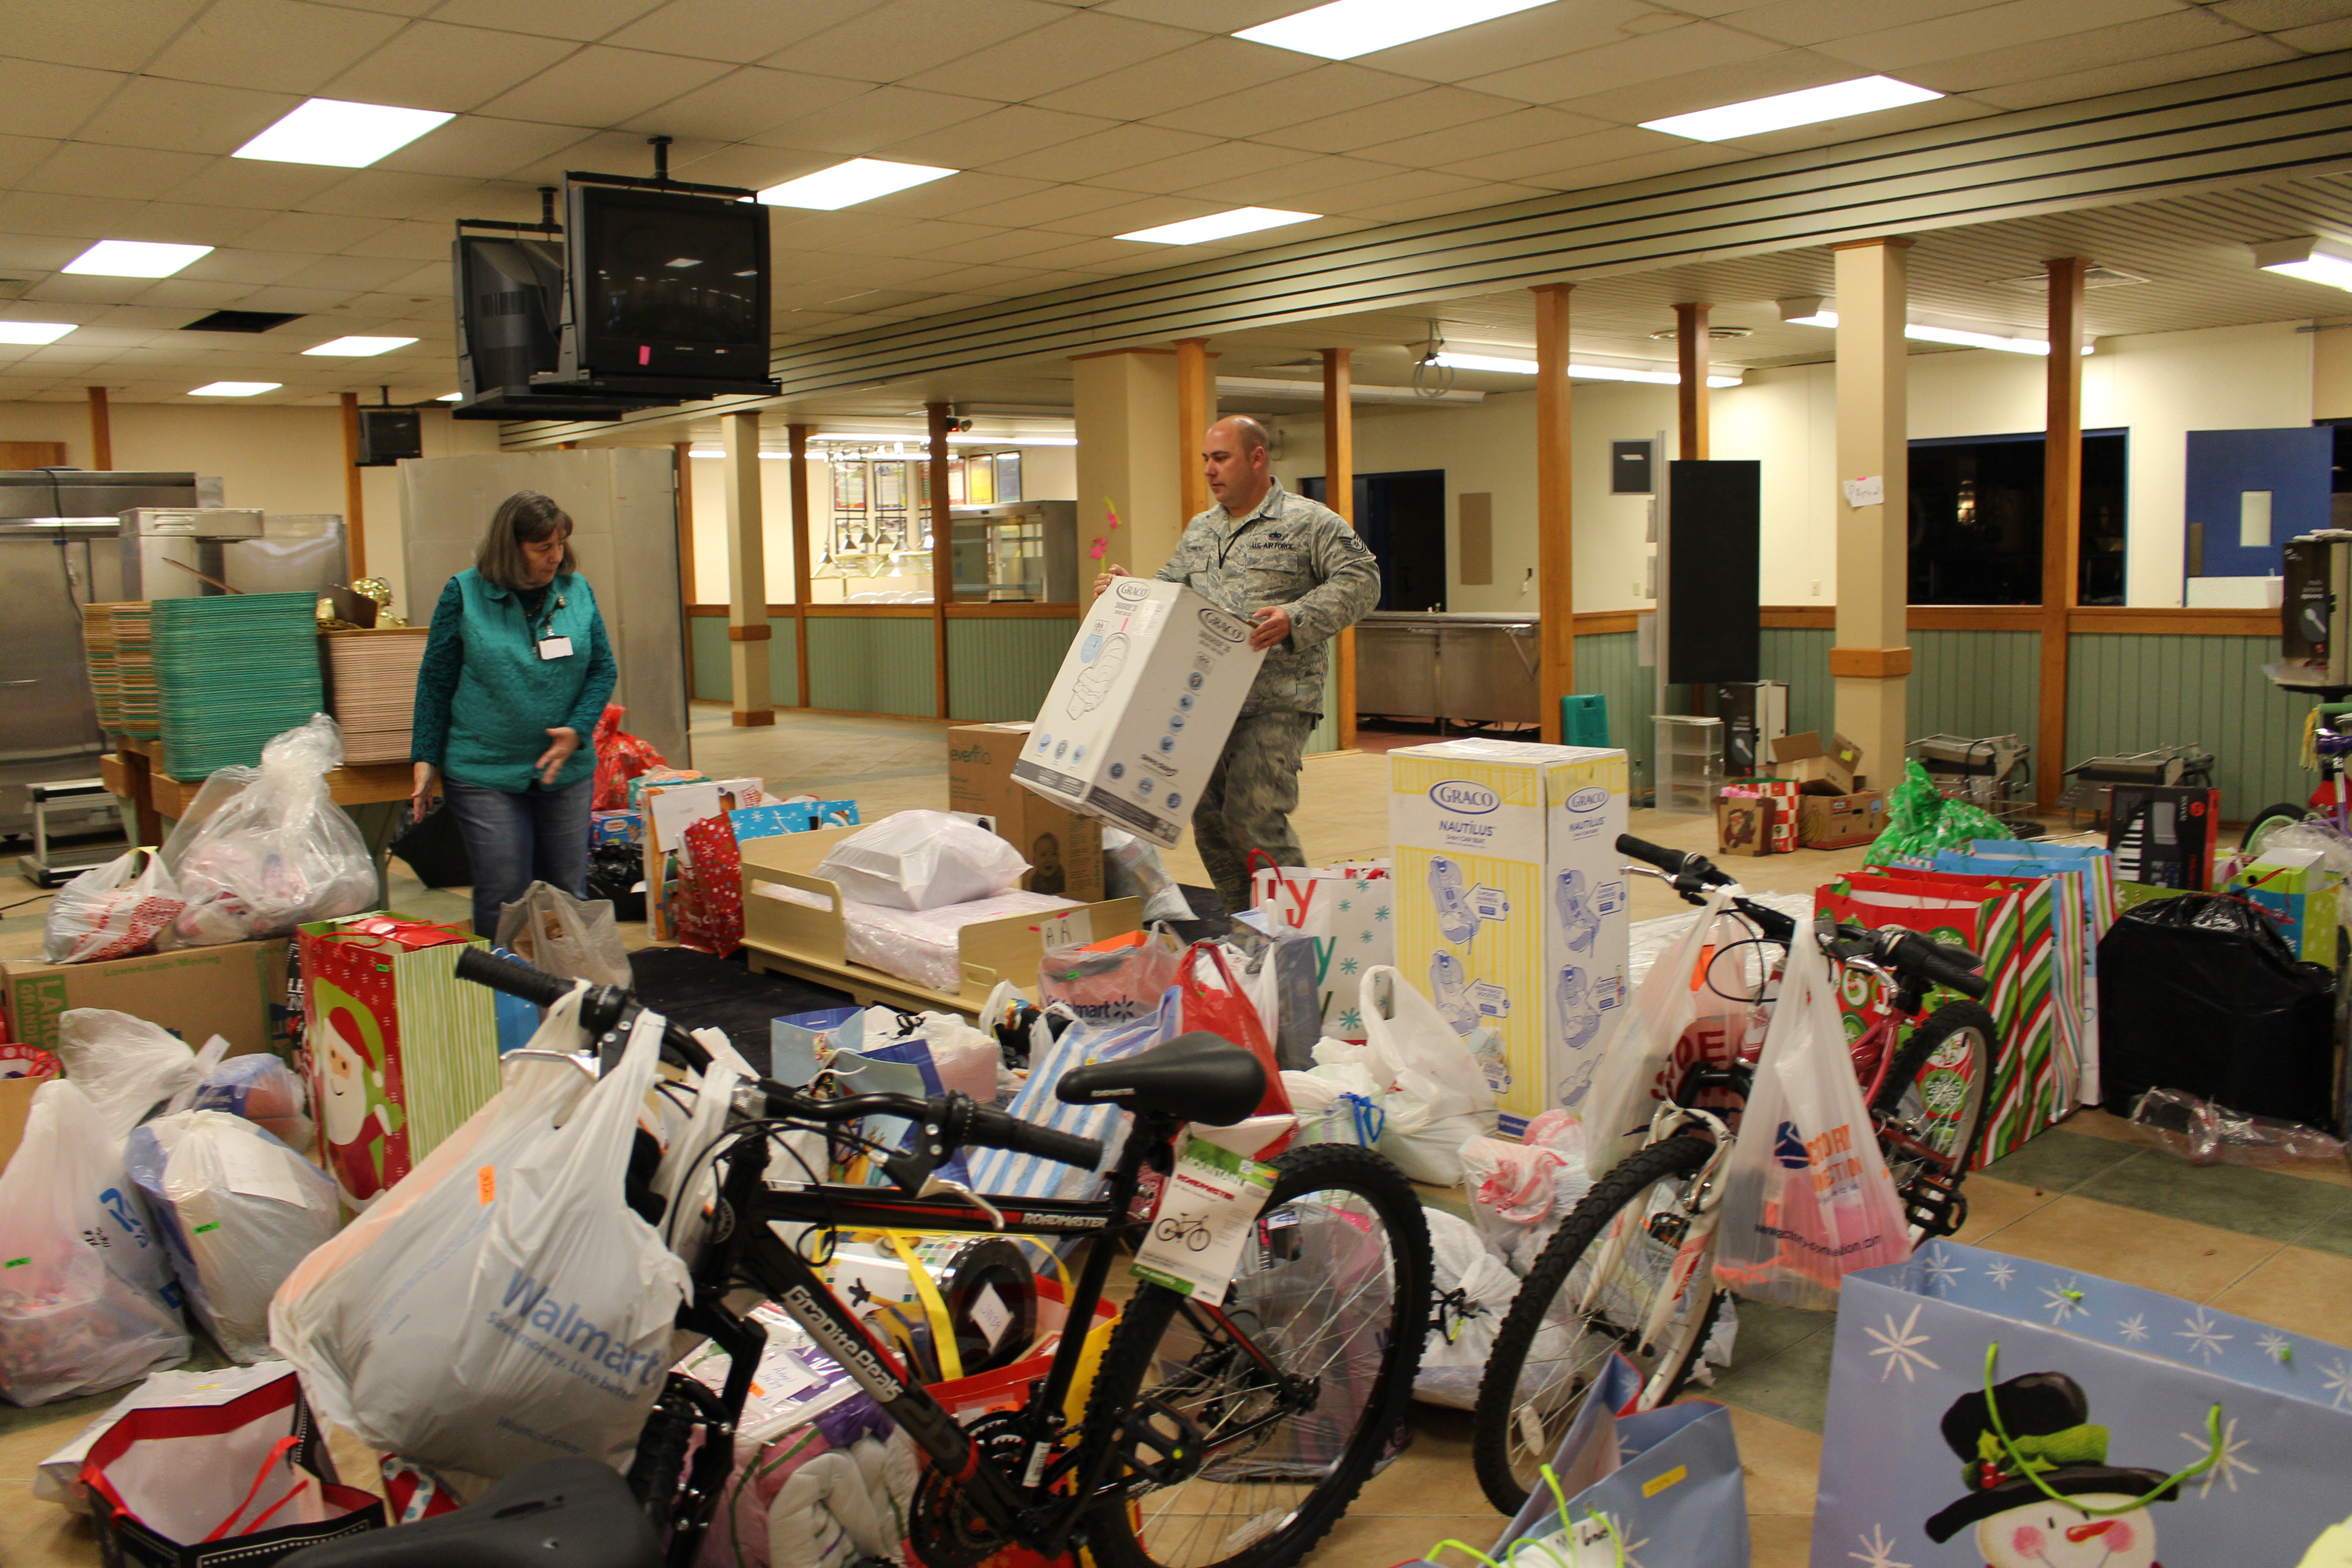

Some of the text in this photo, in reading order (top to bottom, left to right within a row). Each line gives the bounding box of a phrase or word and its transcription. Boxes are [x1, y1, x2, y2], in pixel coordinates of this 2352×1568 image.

[1121, 583, 1149, 597] GRACO
[1440, 786, 1494, 807] GRACO
[1572, 791, 1605, 808] GRACO
[1022, 1212, 1108, 1229] ROADMASTER
[503, 1267, 660, 1386] Walmart
